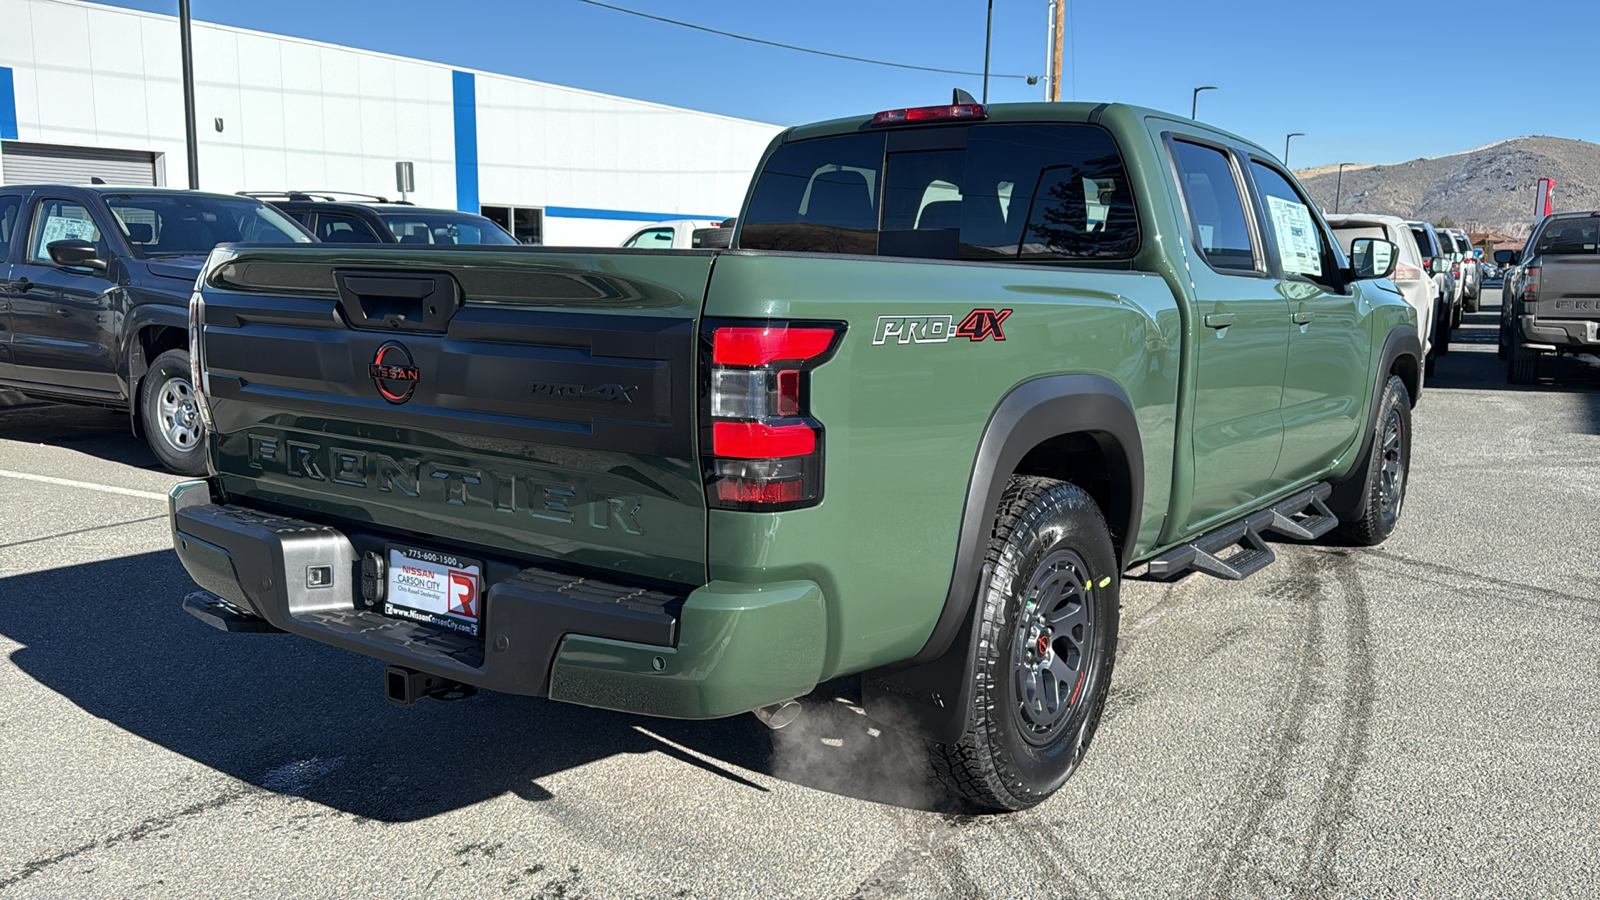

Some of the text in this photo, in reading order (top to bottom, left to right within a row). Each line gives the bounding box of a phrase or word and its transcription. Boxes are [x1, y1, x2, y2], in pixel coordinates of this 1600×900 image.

[370, 365, 418, 380] NISSAN
[247, 433, 645, 535] FRONTIER
[408, 549, 457, 565] 775-600-1500
[402, 565, 435, 579] NISSAN
[397, 574, 441, 590] CARSON CITY
[420, 590, 440, 600] Dealership
[393, 608, 470, 631] www.NissanCarsonCity.com
